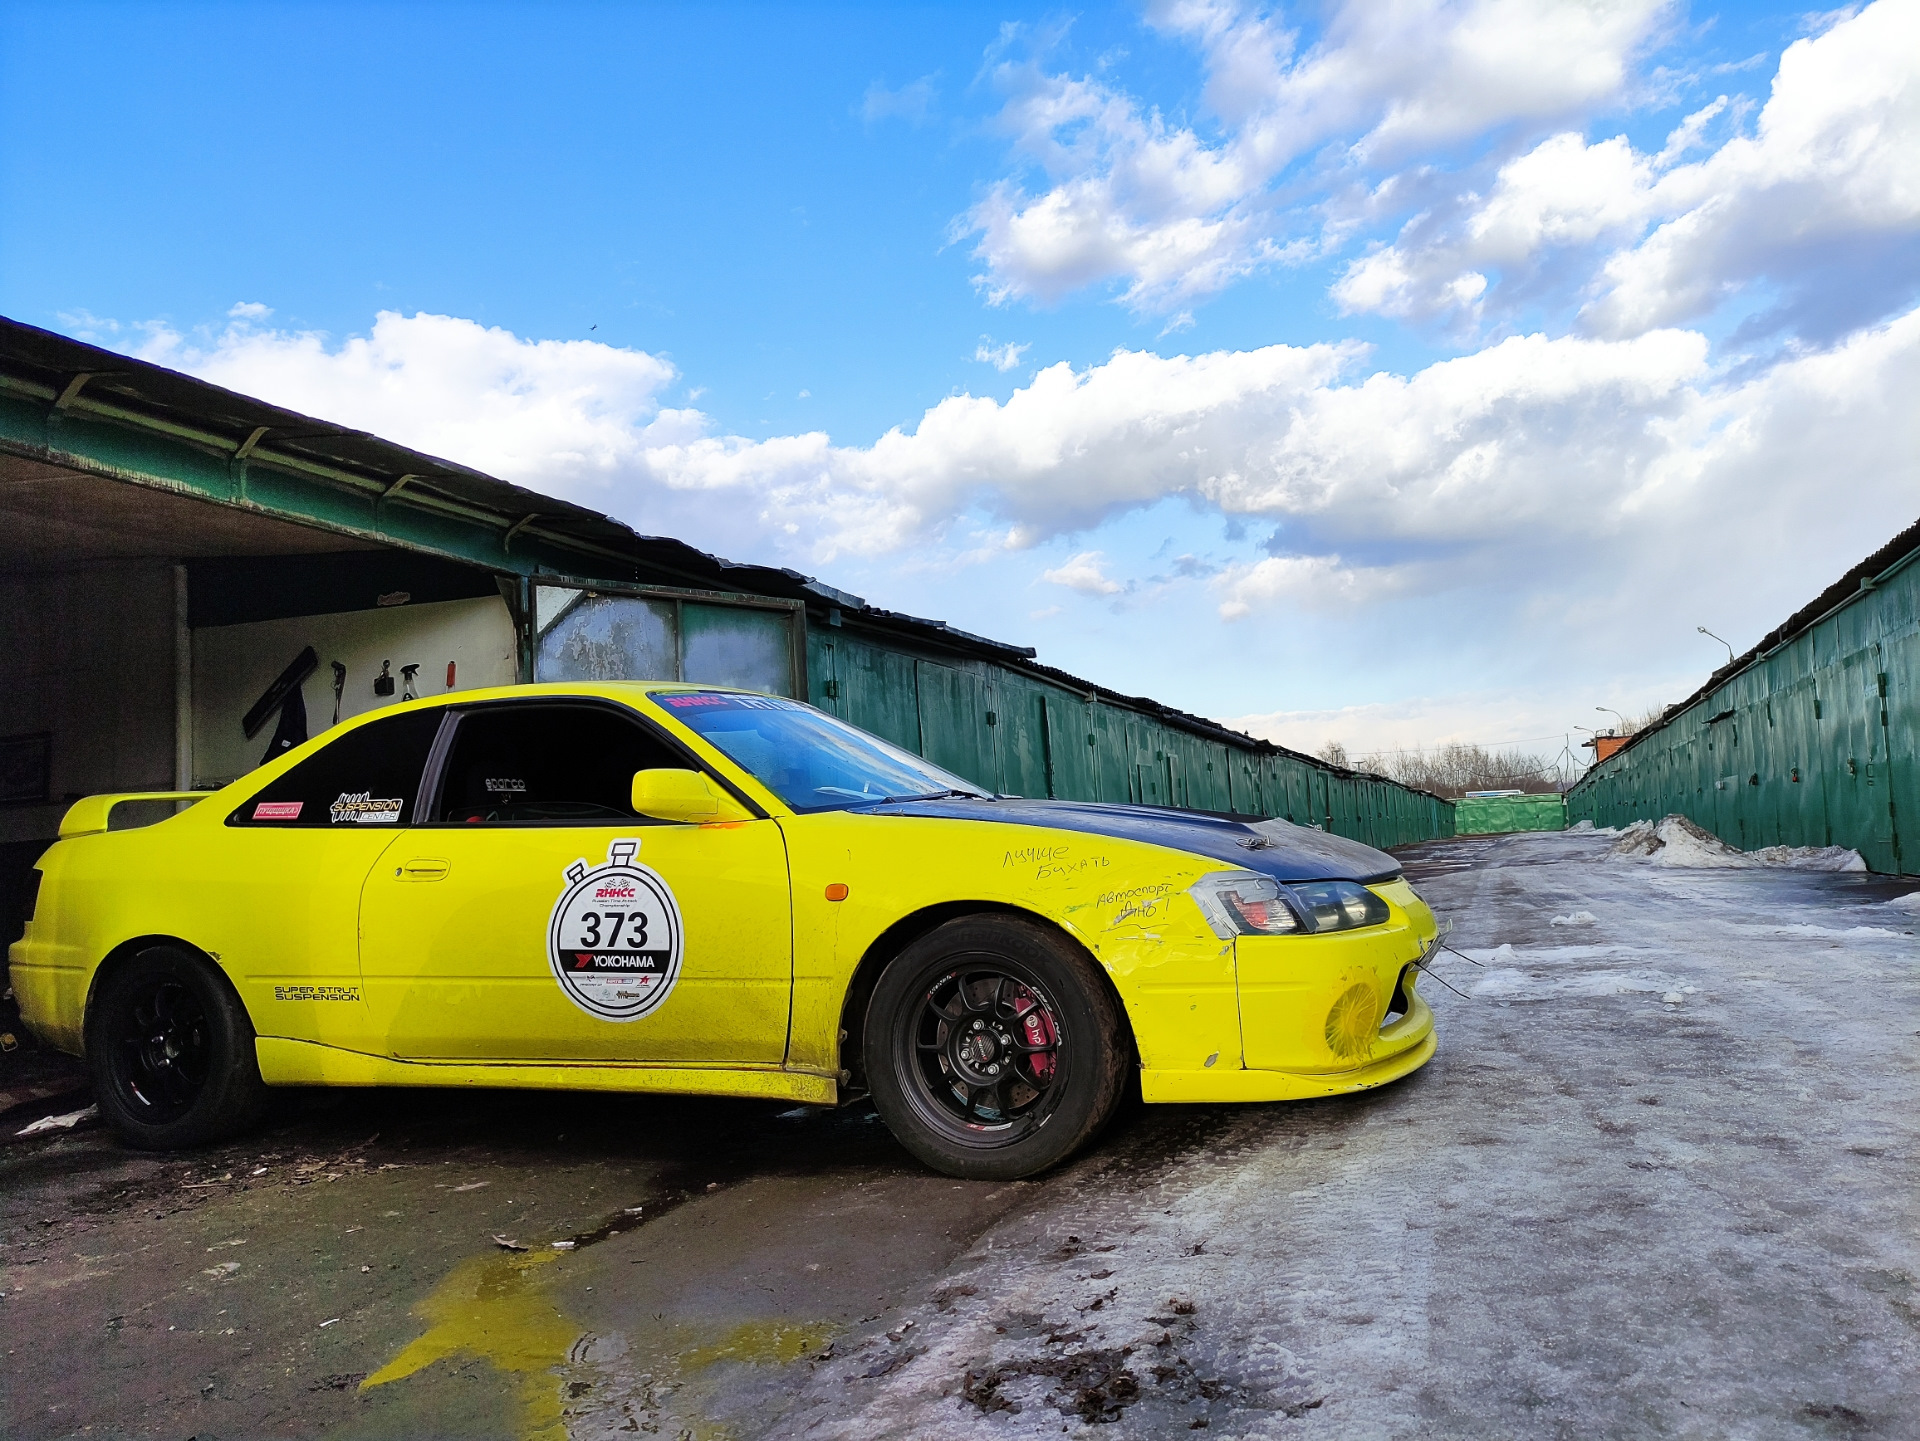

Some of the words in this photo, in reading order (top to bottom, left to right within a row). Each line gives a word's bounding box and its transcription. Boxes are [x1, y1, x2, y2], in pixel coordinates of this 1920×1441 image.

[334, 801, 400, 812] SUSPENSION
[361, 812, 397, 820] CENTER
[595, 888, 636, 898] RHHCC
[580, 911, 649, 949] 373
[593, 953, 655, 968] YOKOHAMA
[274, 986, 315, 994] SUPER
[317, 986, 359, 994] STRUT
[275, 993, 360, 1001] SUSPENSION
